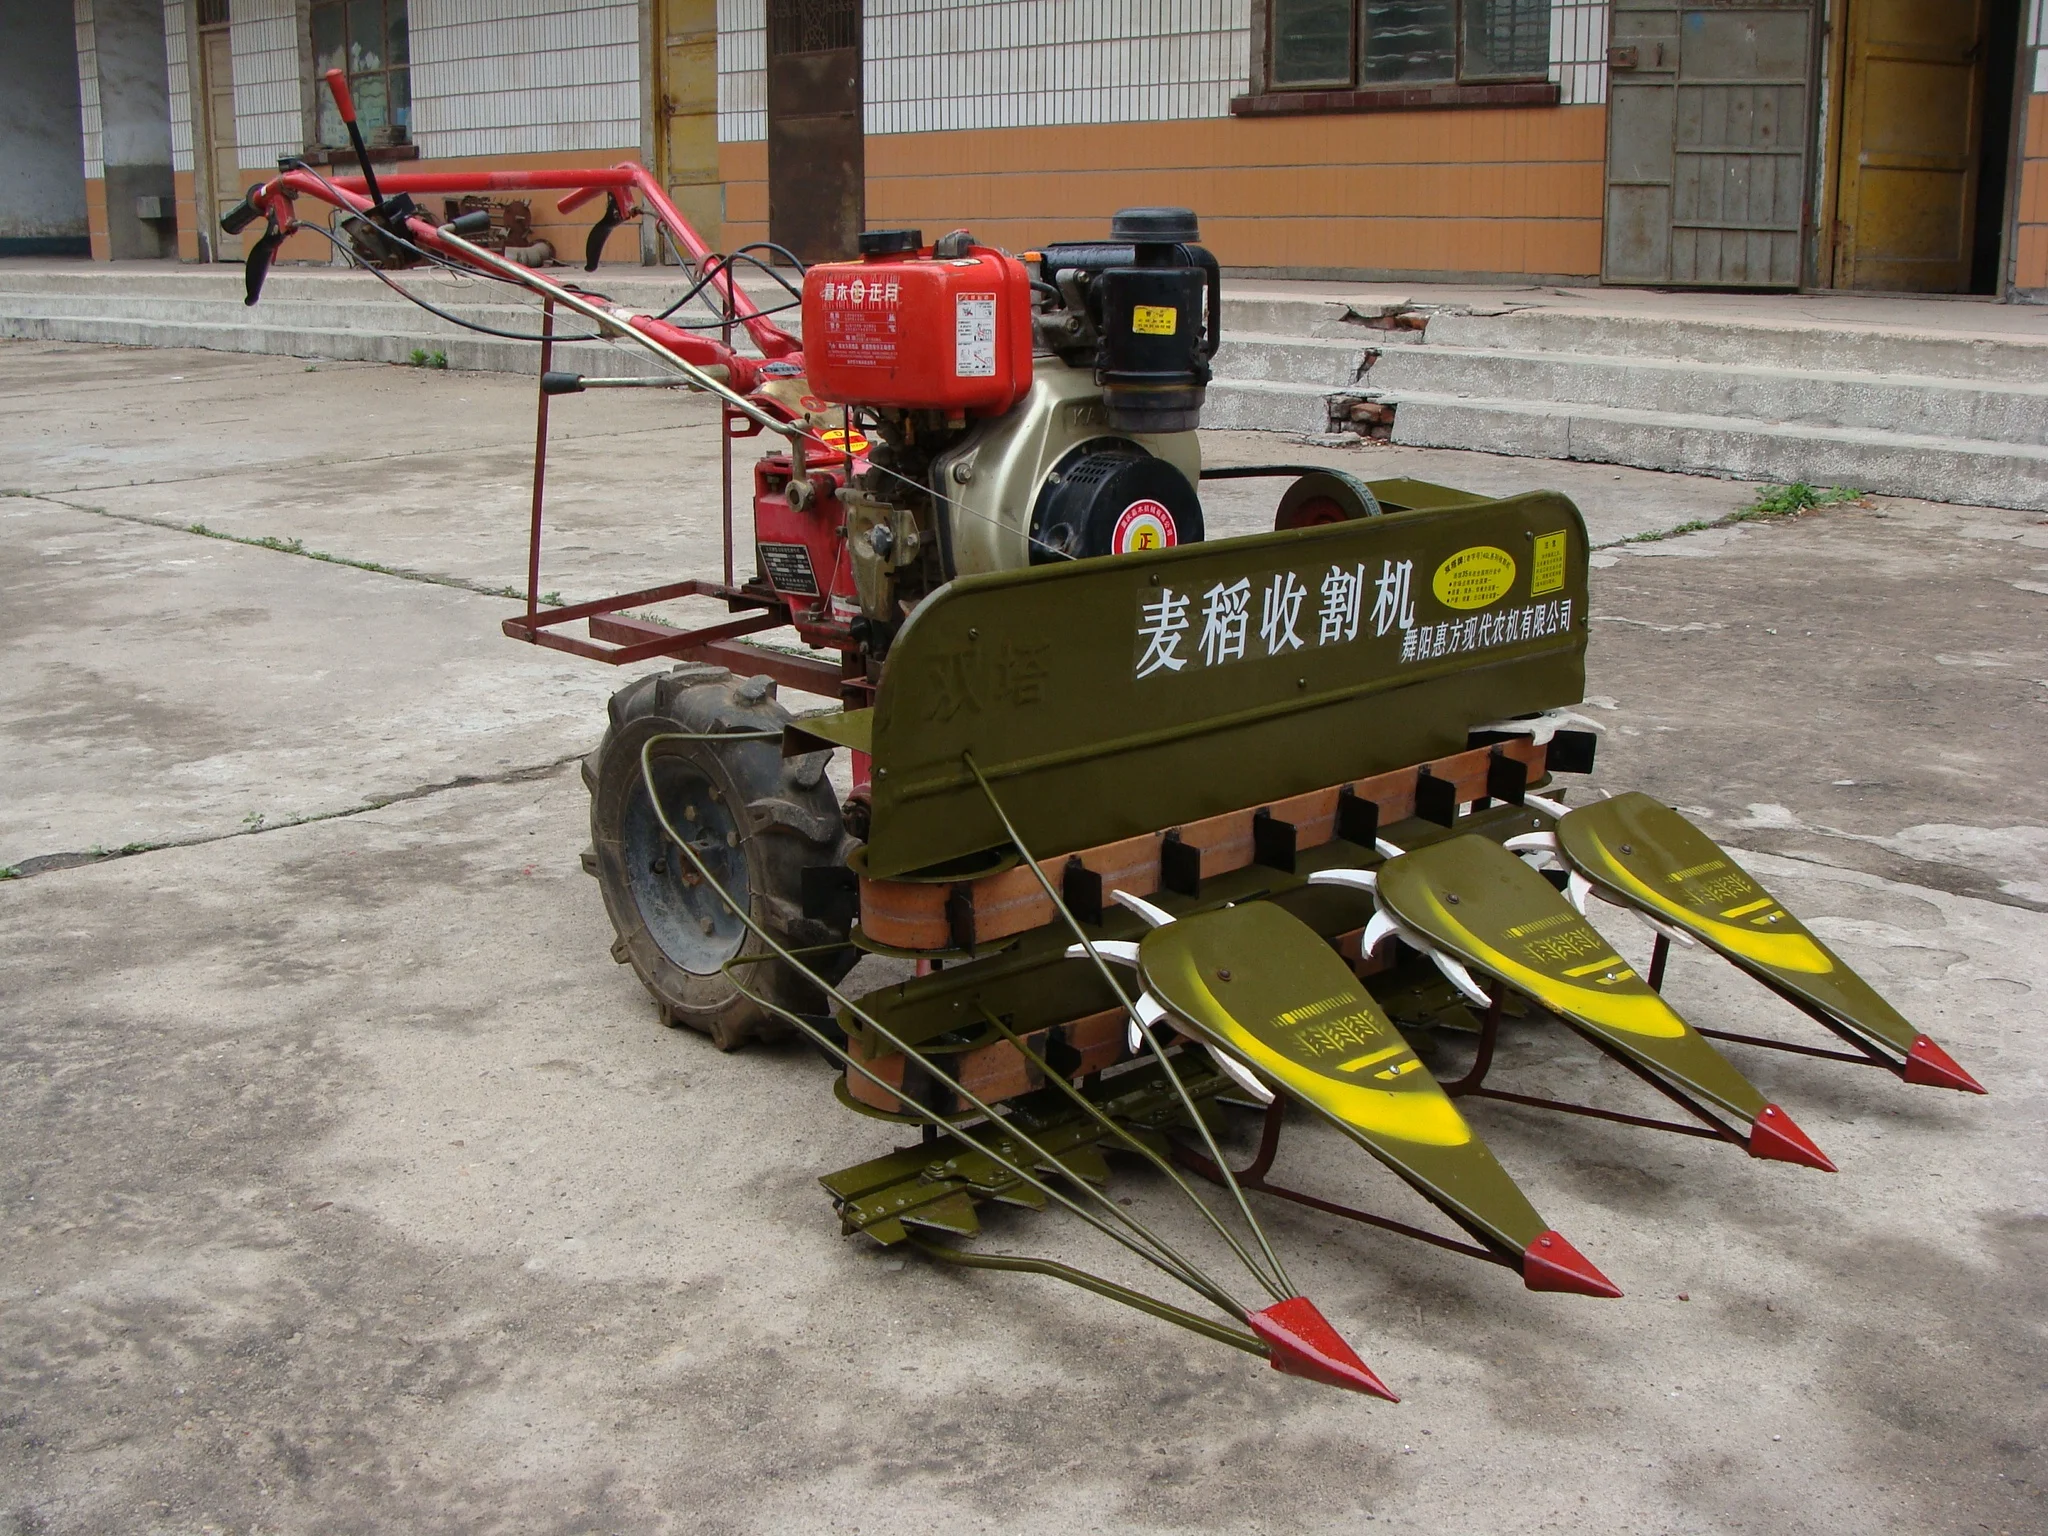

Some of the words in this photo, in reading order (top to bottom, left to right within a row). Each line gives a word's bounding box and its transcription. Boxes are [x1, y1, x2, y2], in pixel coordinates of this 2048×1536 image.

[1136, 560, 1415, 680] 麦稻收割机
[1401, 598, 1572, 664] 舞阳惠方现代农机有限公司
